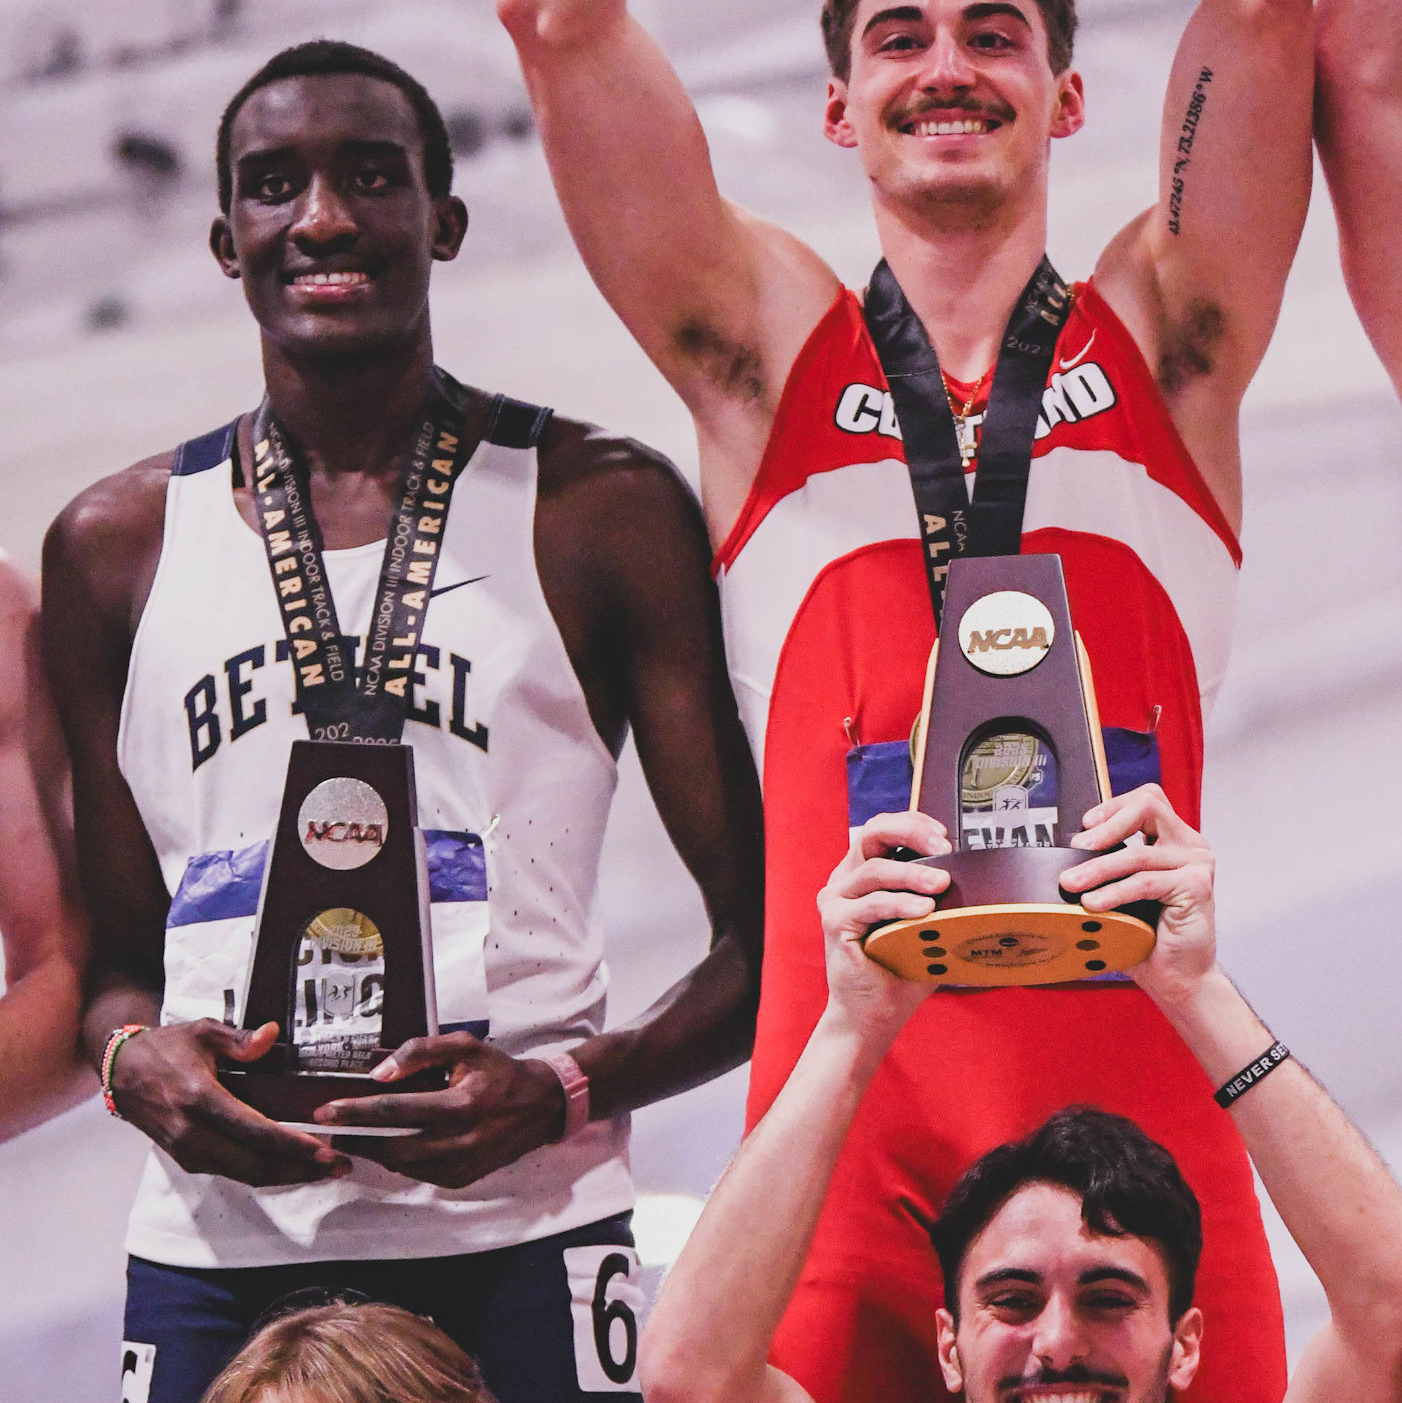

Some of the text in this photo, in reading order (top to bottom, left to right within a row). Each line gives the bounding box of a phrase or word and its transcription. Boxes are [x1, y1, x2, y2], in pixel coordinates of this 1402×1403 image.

[402, 473, 422, 513] TRACK
[253, 438, 325, 688] ALL-AMERICAN
[298, 530, 321, 585] INDOOR
[390, 512, 414, 573] INDOOR
[384, 430, 459, 698] ALL-AMERICAN
[387, 573, 401, 589] III
[311, 585, 333, 631] TRACK
[372, 588, 396, 651] DIVISION
[321, 631, 335, 641] &
[967, 627, 1049, 653] NCAA
[325, 642, 345, 683] FIELD
[364, 654, 383, 697] NCAA
[304, 820, 382, 848] NCAA
[971, 946, 1001, 956] MTM
[1225, 1056, 1274, 1097] NEVER
[592, 1252, 637, 1385] 6
